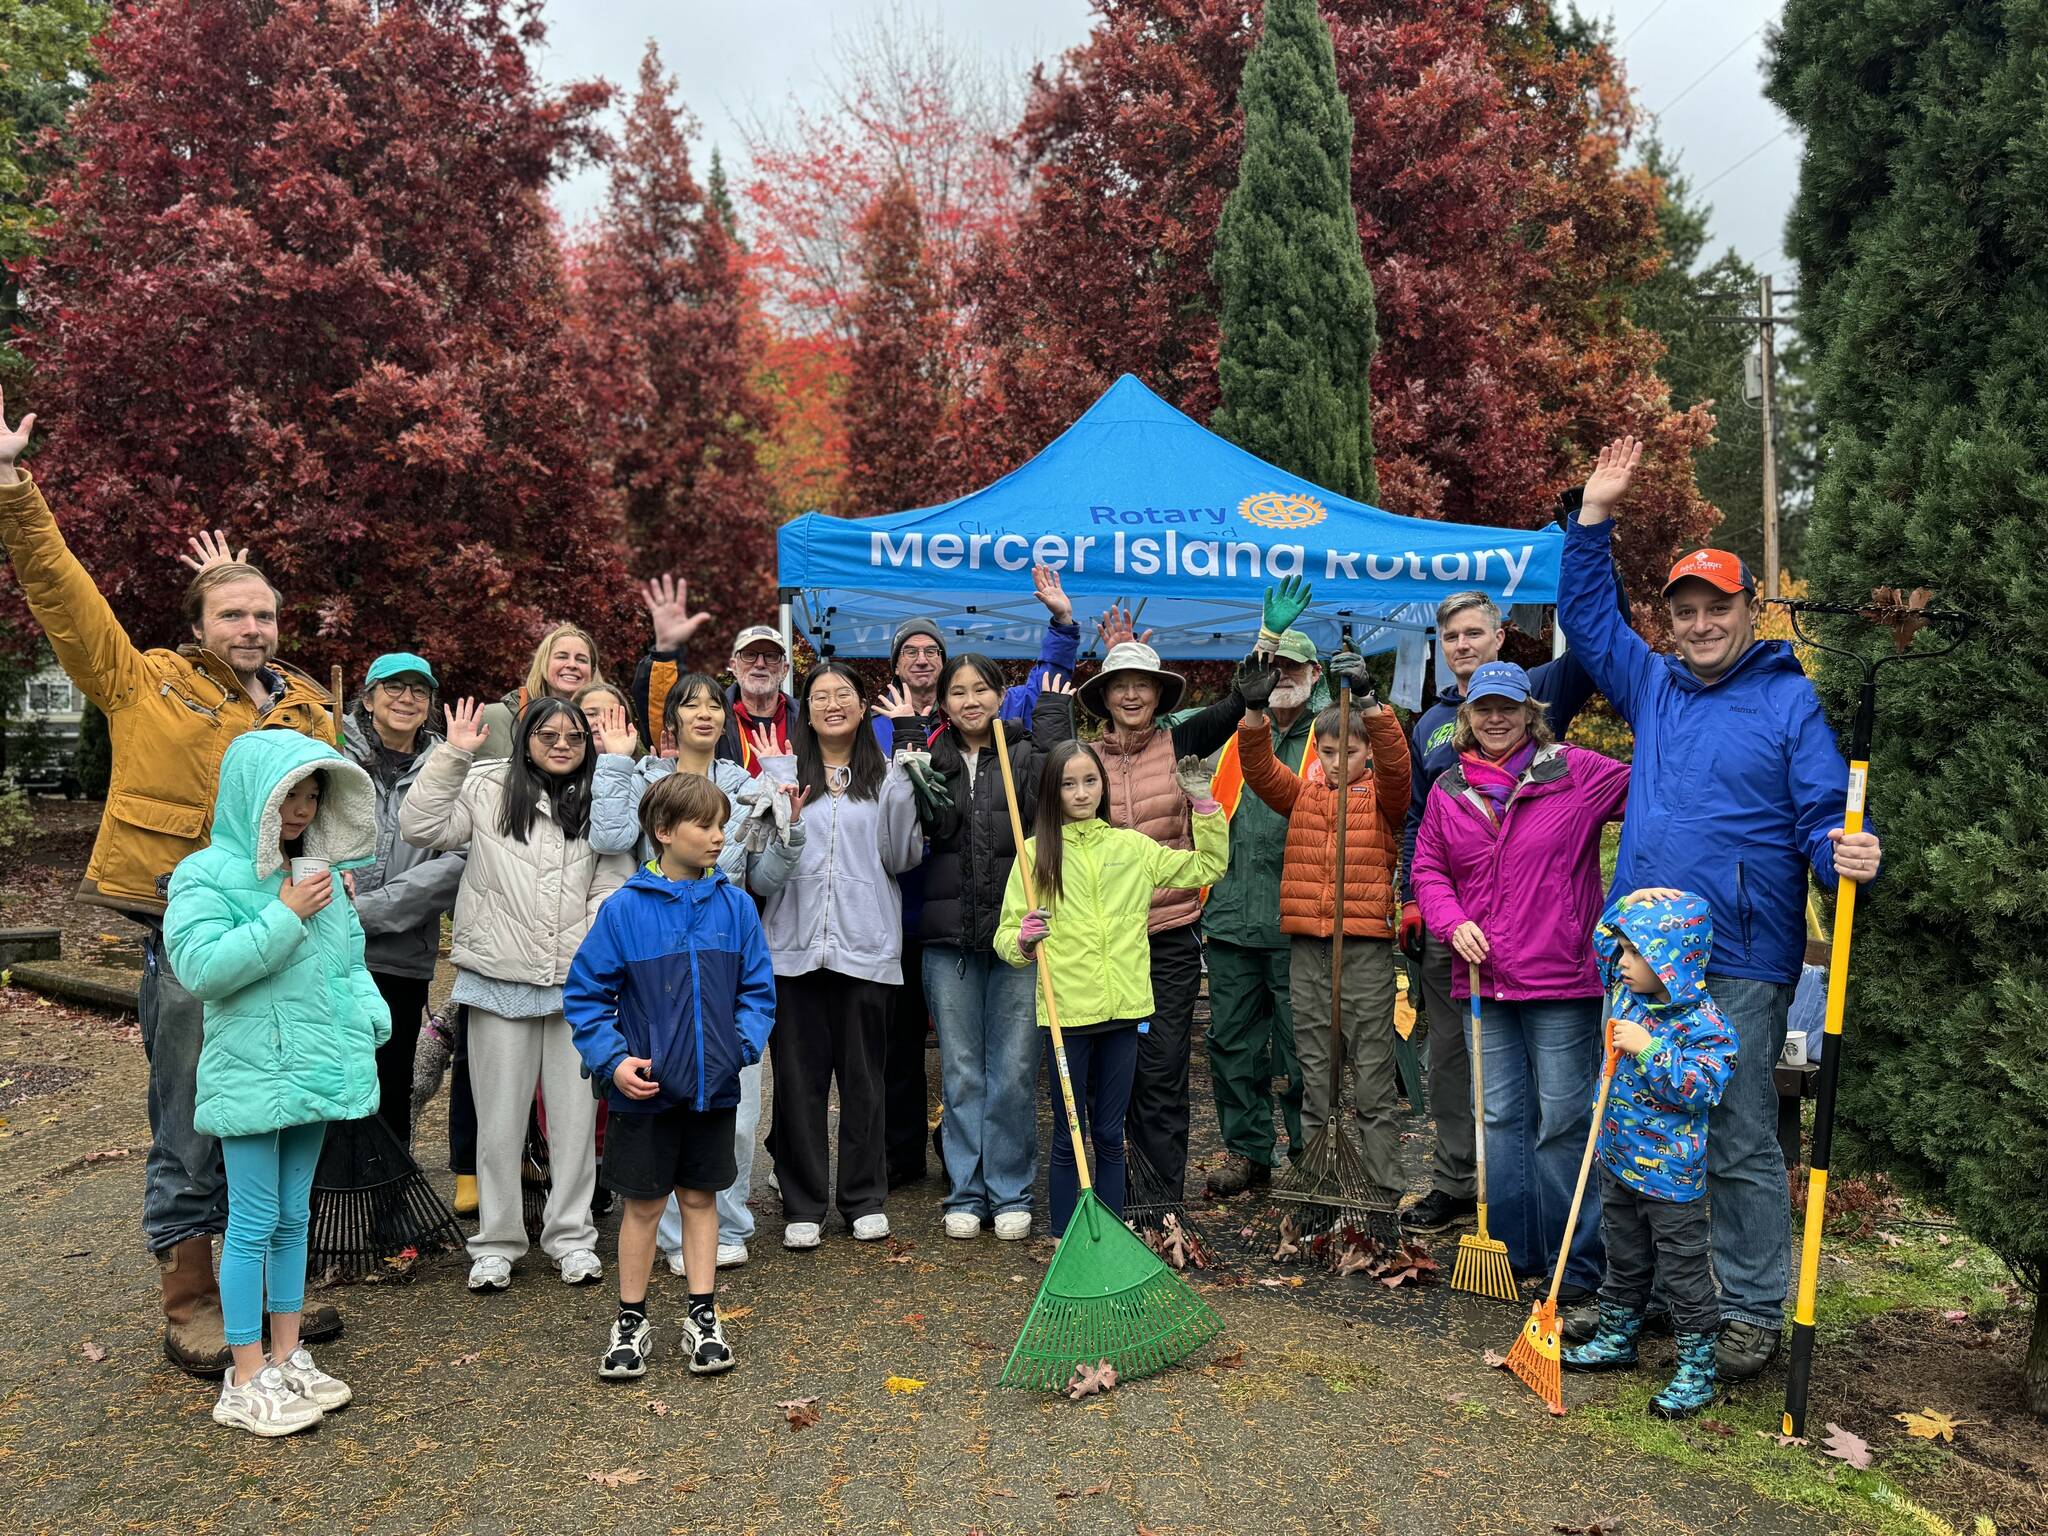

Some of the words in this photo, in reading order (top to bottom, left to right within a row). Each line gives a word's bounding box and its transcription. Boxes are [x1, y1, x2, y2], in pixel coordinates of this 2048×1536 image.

[1089, 506, 1226, 525] Rotary
[871, 531, 1095, 573] Mercer
[1114, 529, 1305, 579] Island
[1325, 545, 1534, 597] Rotary
